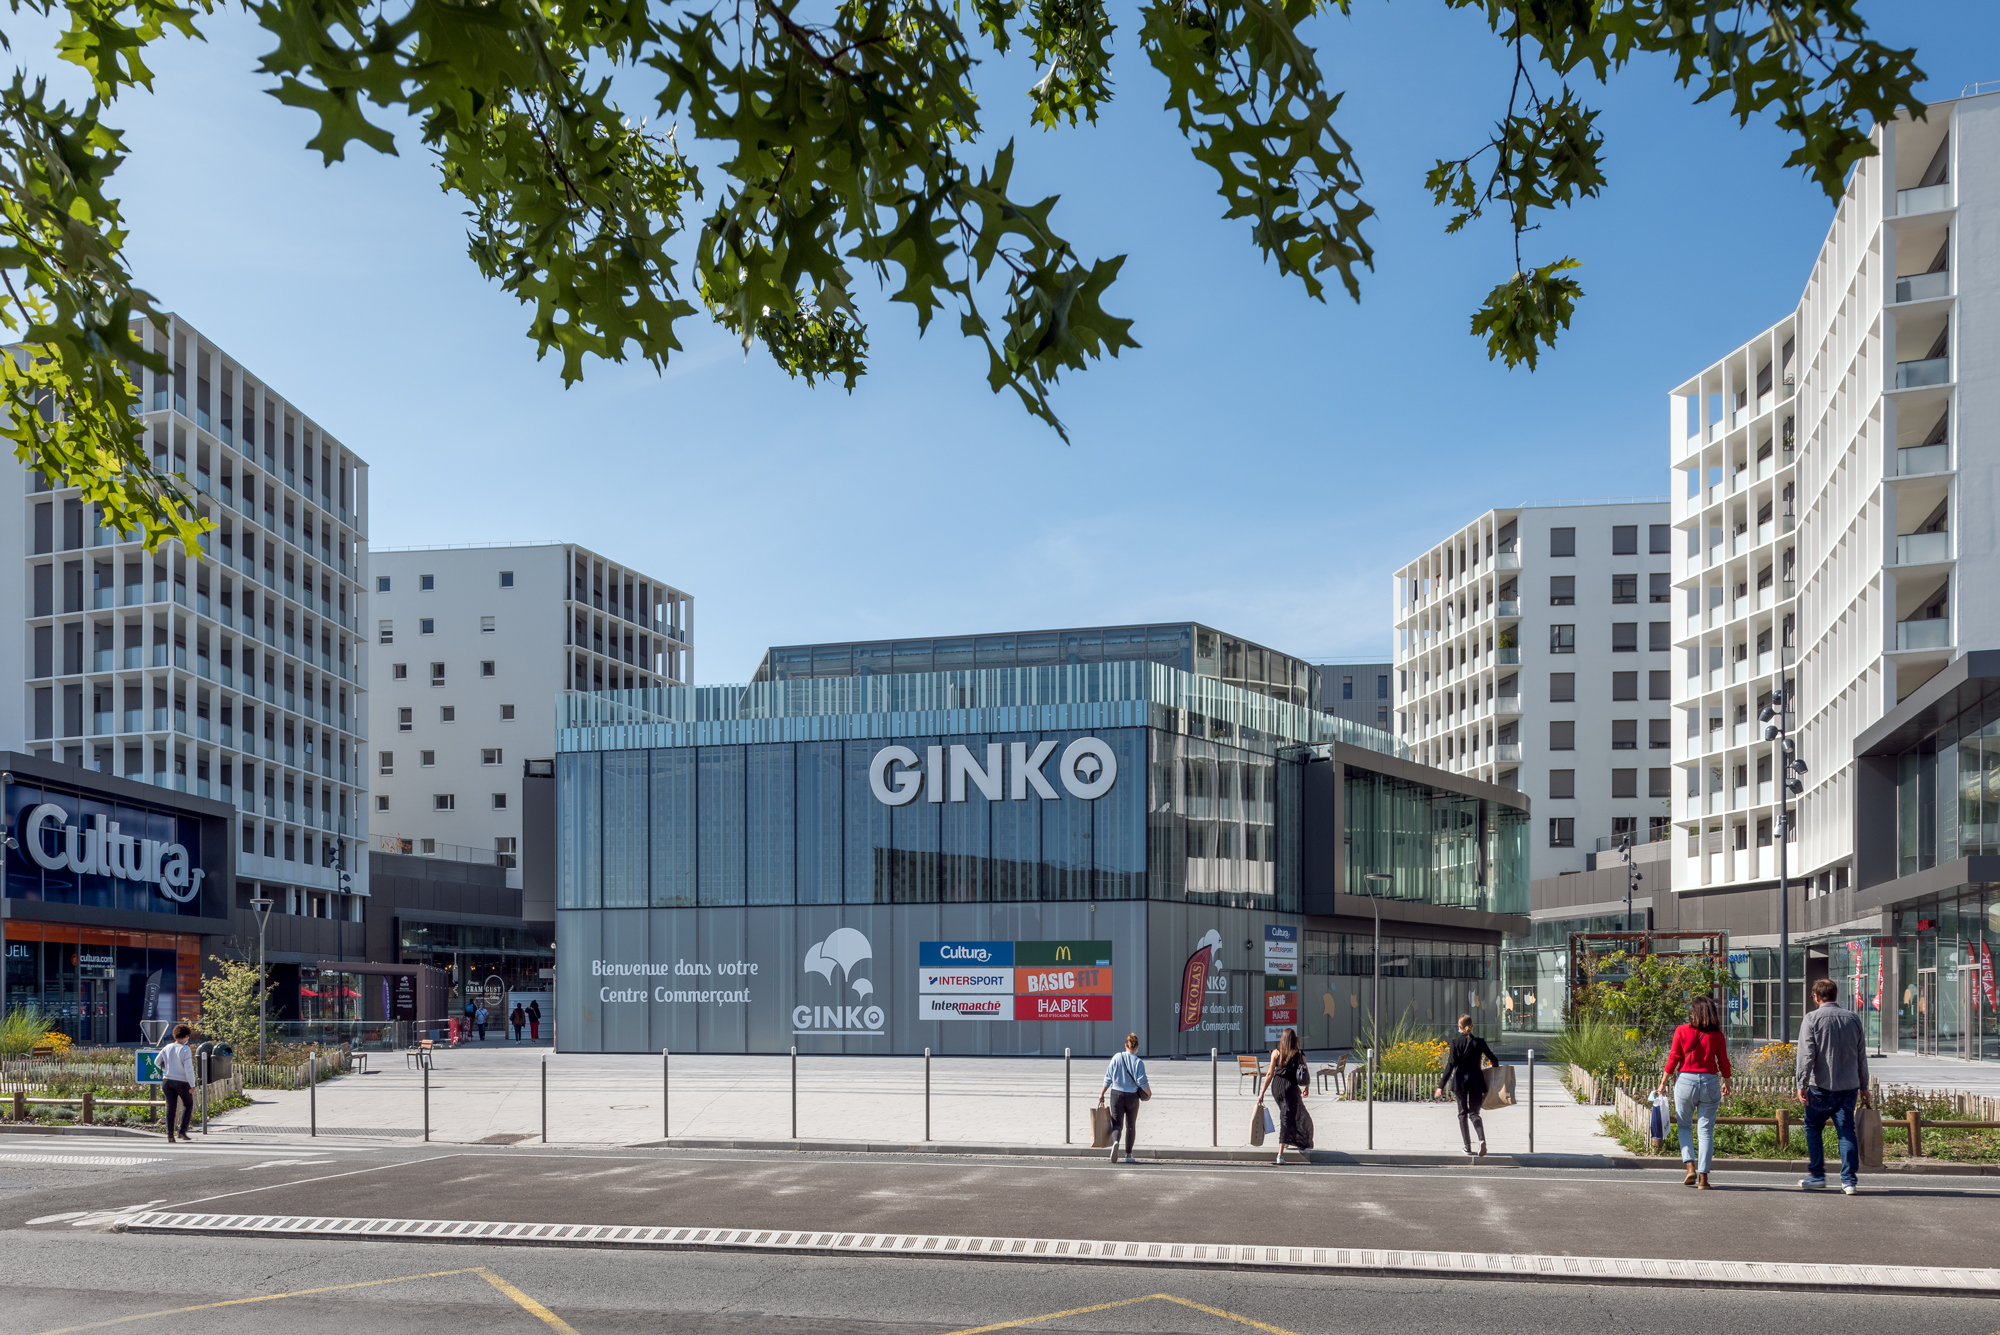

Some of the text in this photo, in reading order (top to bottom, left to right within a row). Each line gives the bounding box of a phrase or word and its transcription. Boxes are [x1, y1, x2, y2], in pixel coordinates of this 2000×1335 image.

[869, 737, 1117, 805] GINKO
[26, 803, 205, 902] Cultura
[1272, 927, 1290, 939] Cultura
[5, 945, 29, 957] UEIL
[80, 954, 113, 962] cultura.com
[940, 945, 992, 962] Cultura
[592, 959, 759, 976] Bienvenue dans votre
[939, 976, 1004, 986] INTERSPORT
[1207, 976, 1227, 990] NKO
[599, 986, 752, 1007] Centre Commerçant
[1187, 965, 1202, 1022] NICOLAS
[932, 1000, 1001, 1012] Intermarché
[1210, 1002, 1226, 1014] dans
[1227, 1003, 1243, 1014] votre
[792, 1005, 885, 1029] GINKO
[1202, 1020, 1240, 1033] Commerçant
